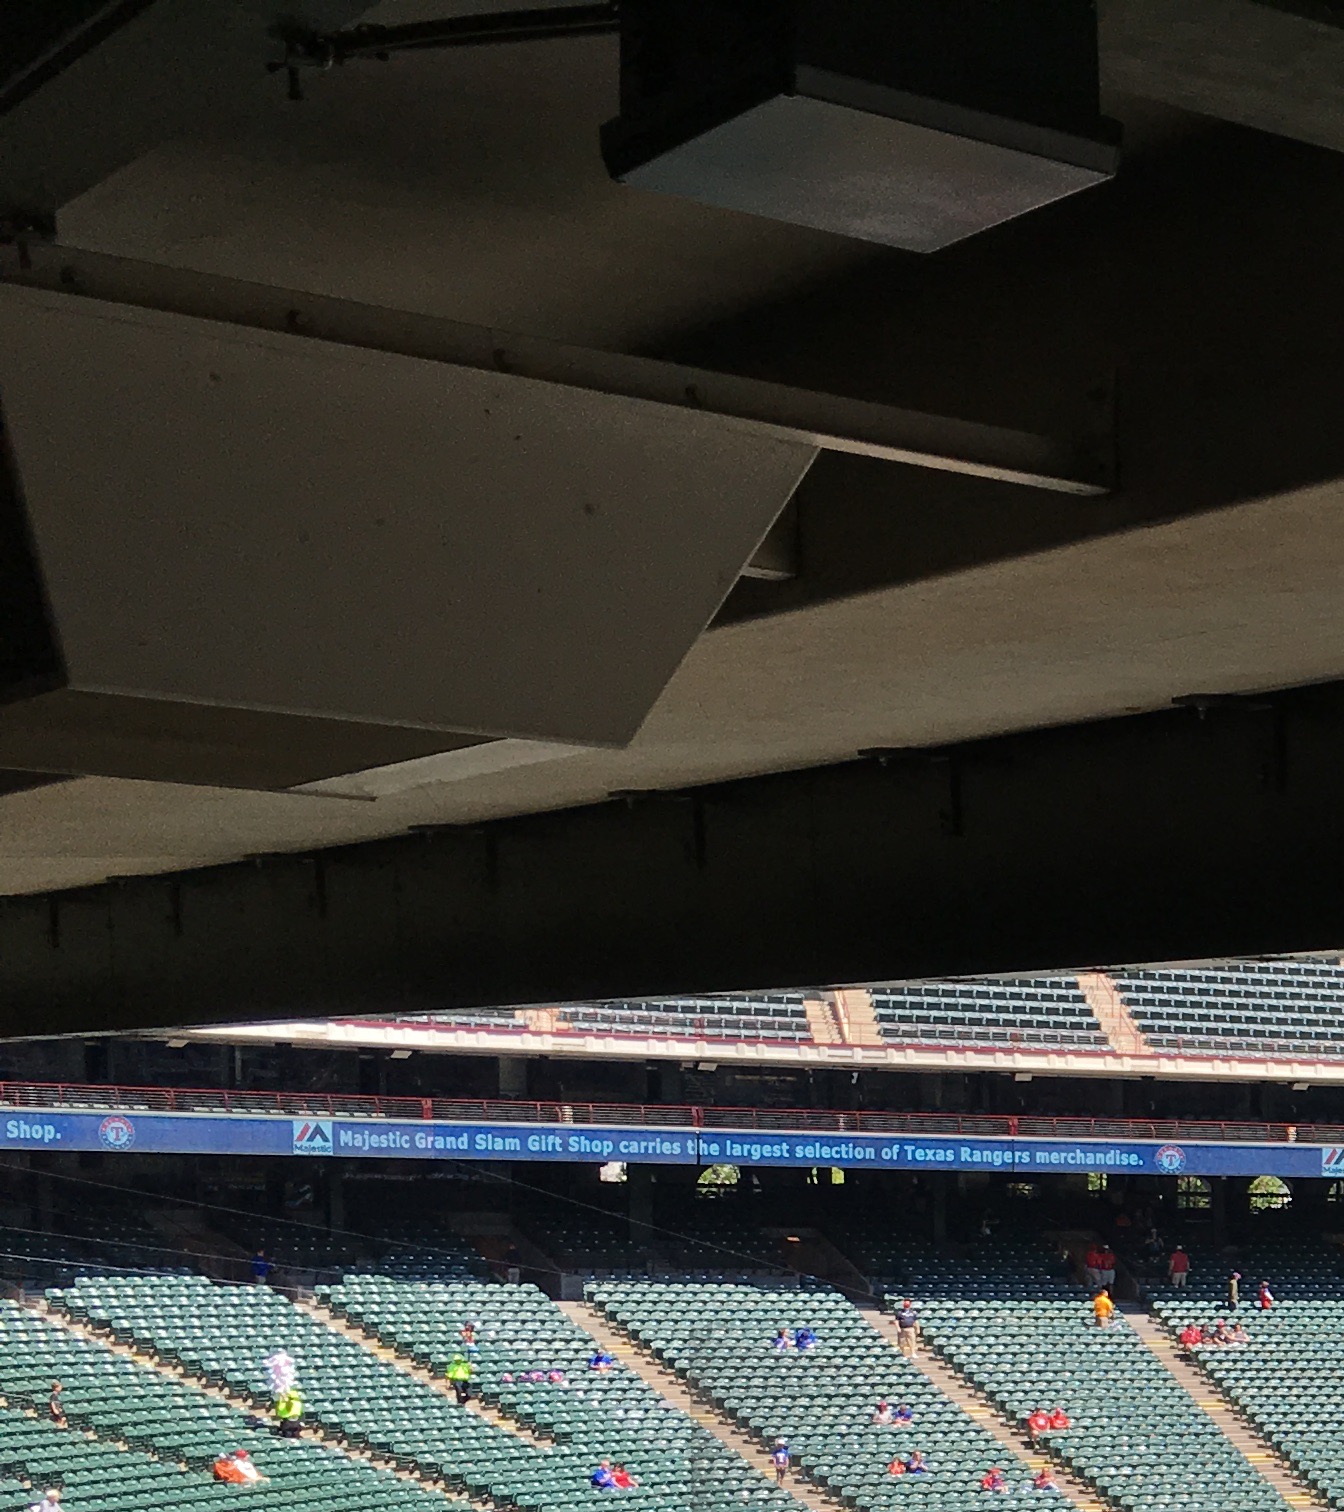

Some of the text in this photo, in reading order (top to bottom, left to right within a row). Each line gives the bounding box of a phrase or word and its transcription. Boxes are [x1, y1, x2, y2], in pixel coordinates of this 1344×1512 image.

[5, 1120, 61, 1143] Shop.
[340, 1130, 1144, 1167] Majestic Grand Slam Gift Shop carries the largest selection of Texas Rangers merchandise.
